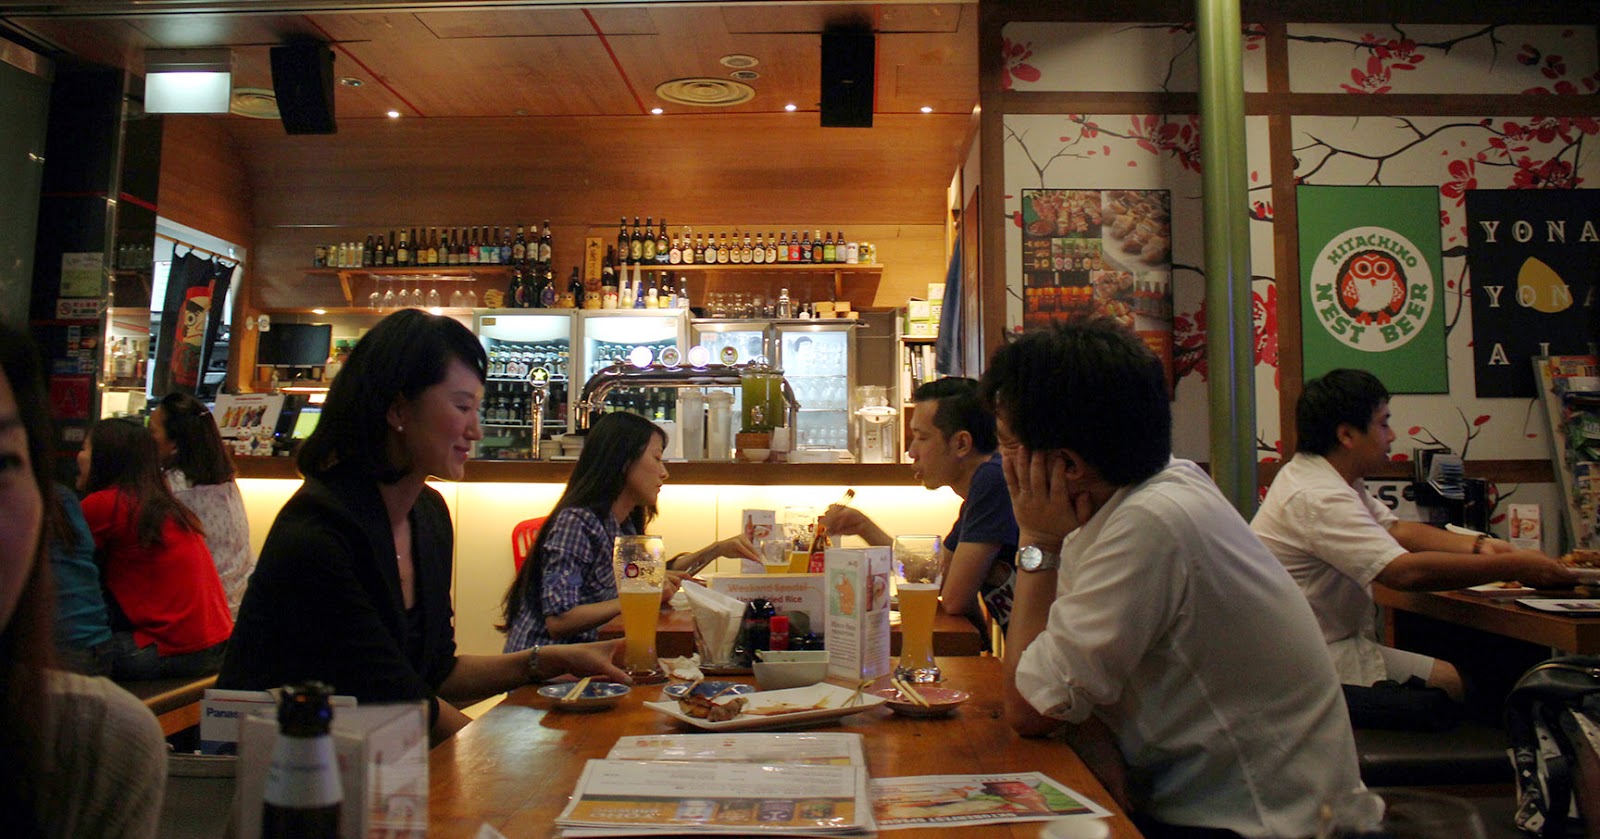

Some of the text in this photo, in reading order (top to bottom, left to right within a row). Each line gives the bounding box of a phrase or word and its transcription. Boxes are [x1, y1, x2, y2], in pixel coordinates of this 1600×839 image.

[1479, 220, 1600, 243] YONA
[1327, 233, 1418, 269] HITACHINO
[1315, 282, 1429, 344] NEST BEER
[785, 595, 802, 603] Rice
[206, 707, 243, 719] Panas
